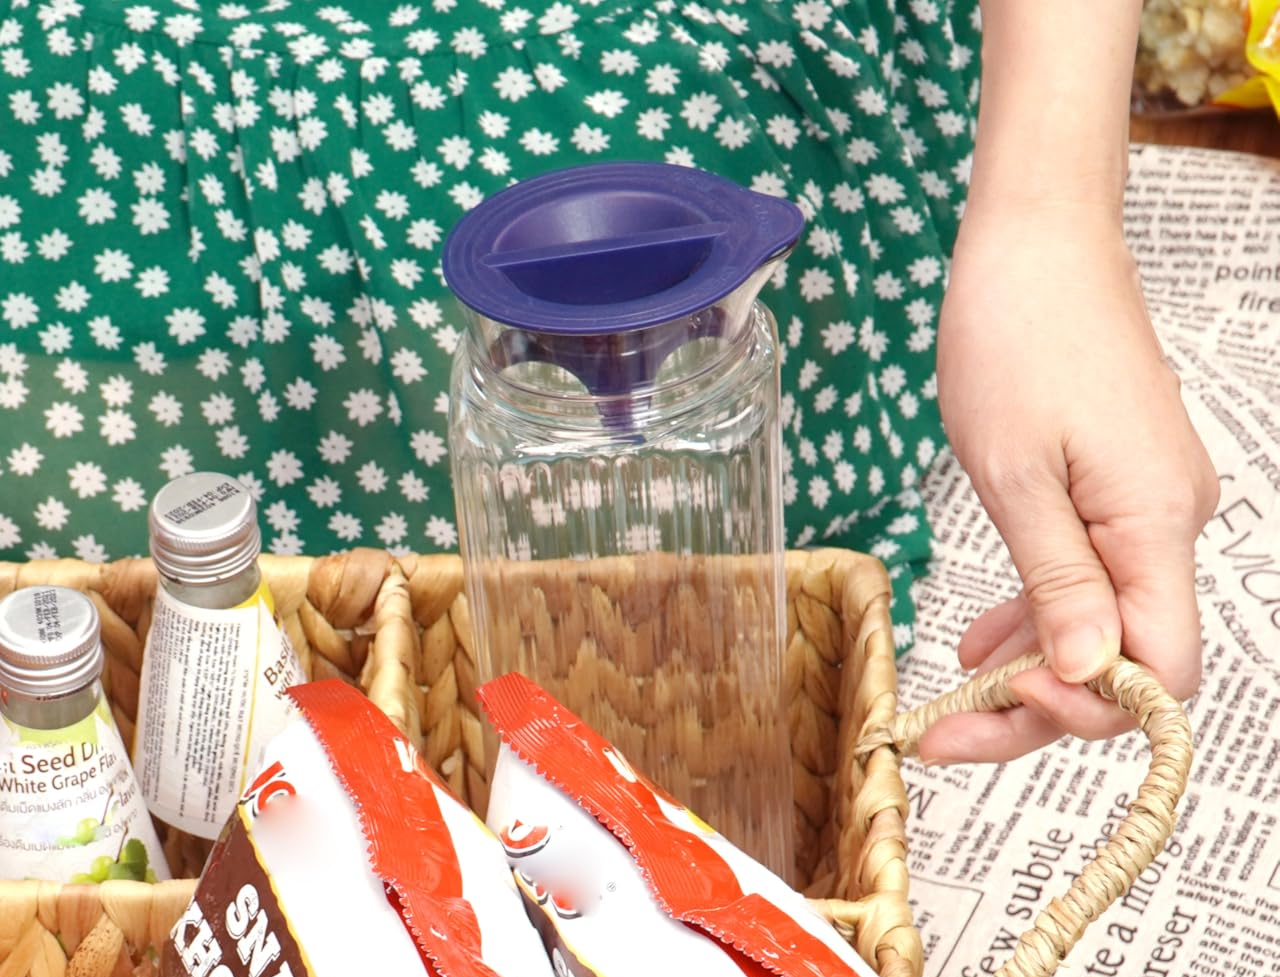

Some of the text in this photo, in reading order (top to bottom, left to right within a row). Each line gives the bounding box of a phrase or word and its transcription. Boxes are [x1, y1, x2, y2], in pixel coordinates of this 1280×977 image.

[20, 744, 77, 776] Seed
[50, 765, 98, 792] Grape
[1005, 828, 1075, 921] subtle
[1106, 922, 1139, 945] a
